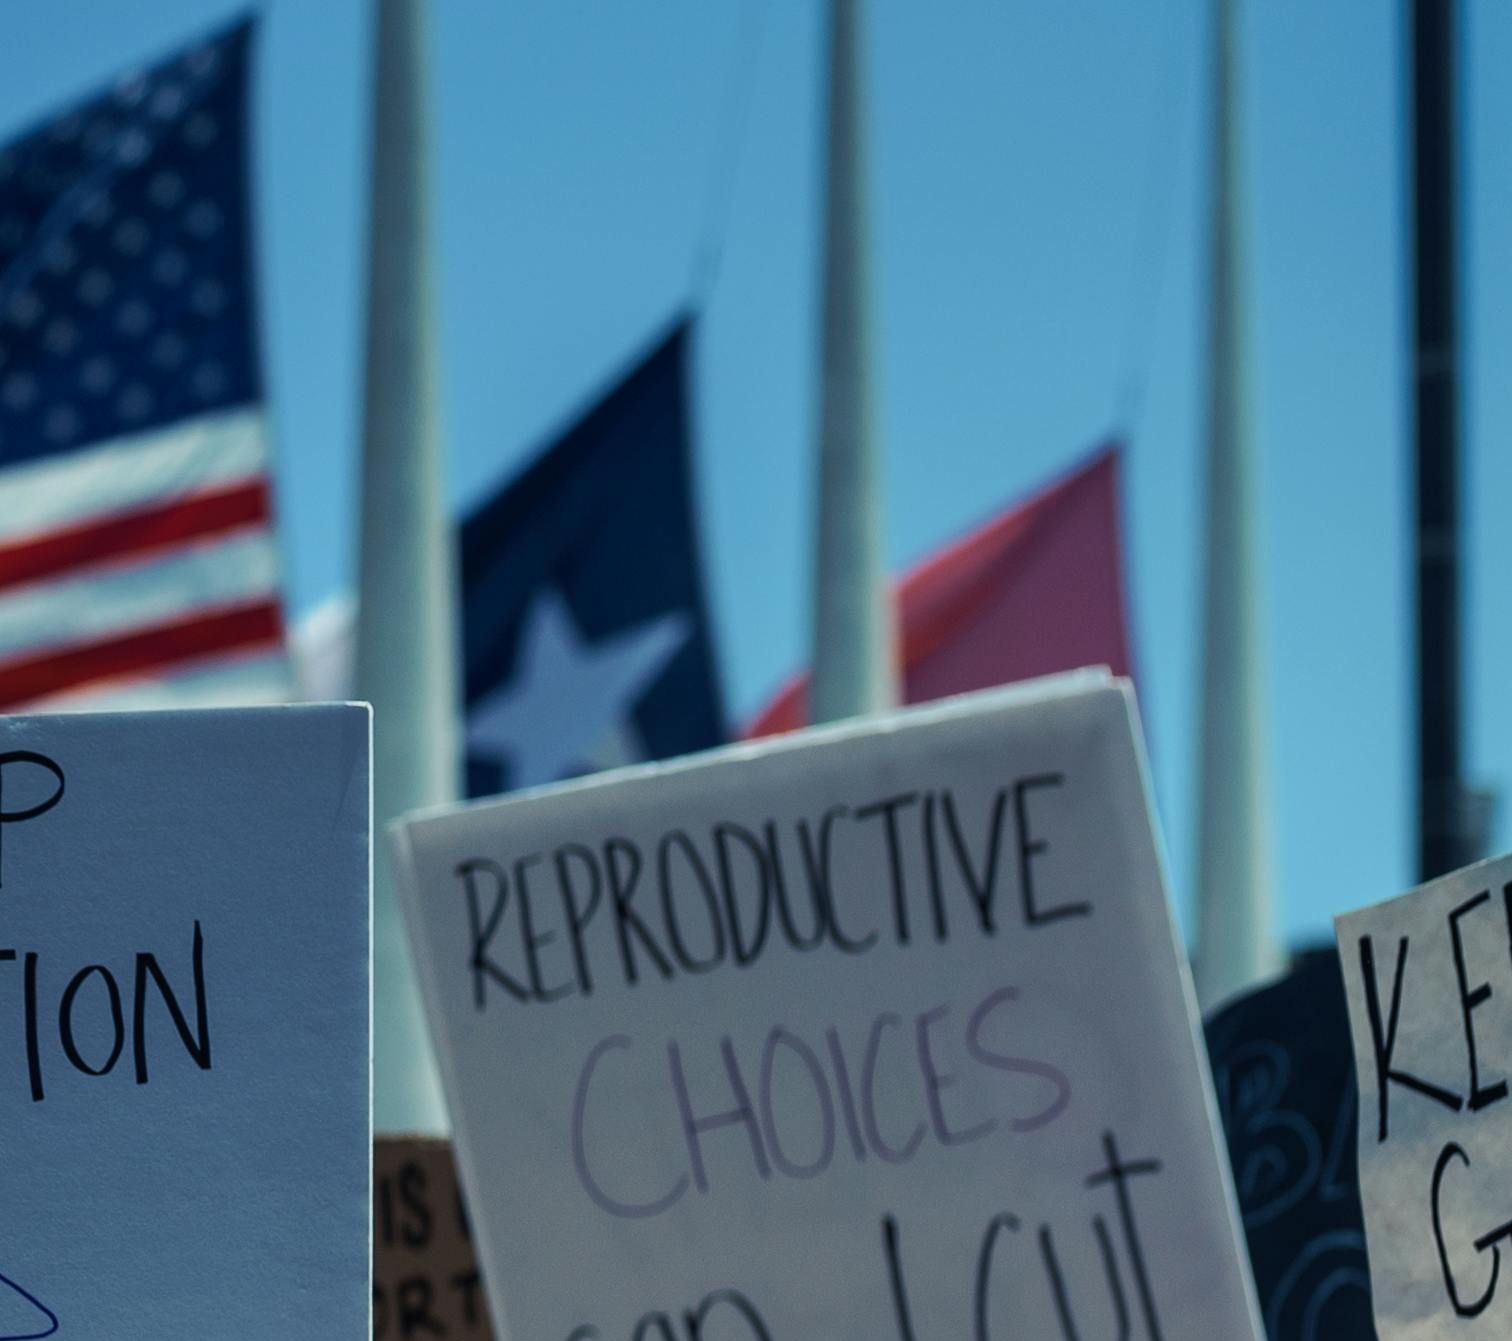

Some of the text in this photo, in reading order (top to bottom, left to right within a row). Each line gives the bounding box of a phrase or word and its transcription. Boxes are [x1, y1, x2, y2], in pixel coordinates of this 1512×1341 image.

[455, 773, 1093, 1012] REPRODUCTIVE
[0, 918, 212, 1102] ION
[571, 986, 1074, 1218] CHOICES
